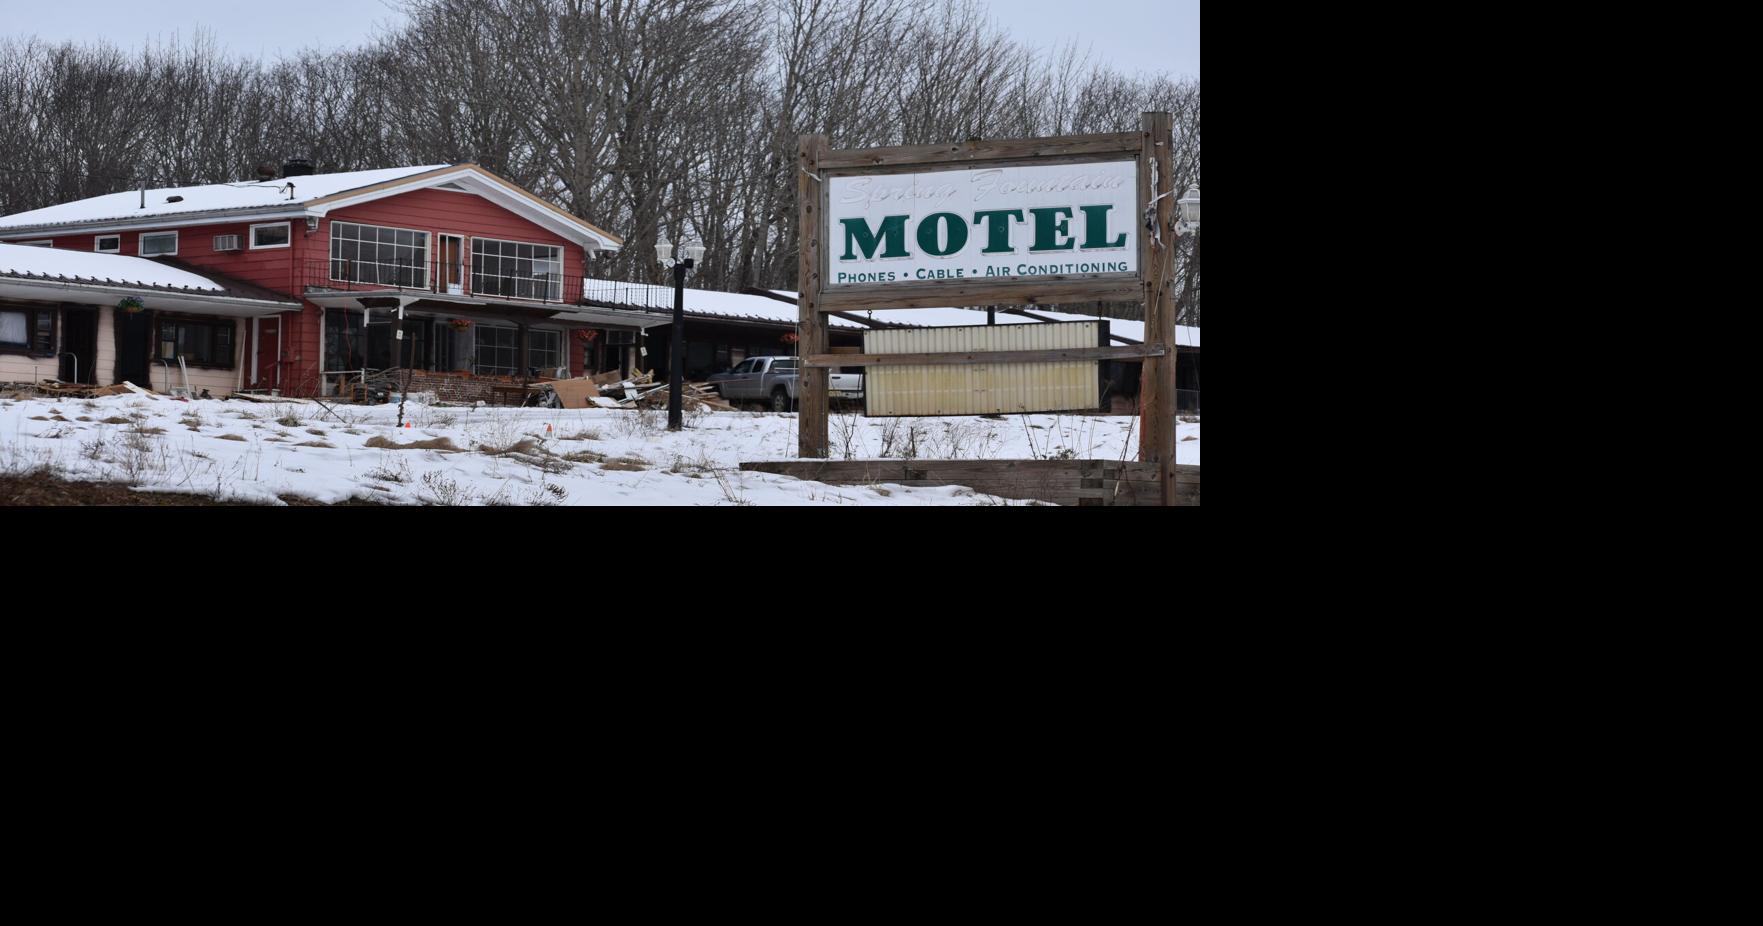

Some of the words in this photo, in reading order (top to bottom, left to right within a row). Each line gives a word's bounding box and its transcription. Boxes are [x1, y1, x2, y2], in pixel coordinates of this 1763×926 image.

[839, 177, 956, 209] Spring
[971, 169, 1123, 202] Fountain
[839, 204, 1128, 261] MOTEL
[838, 271, 896, 284] PHONES
[916, 268, 965, 280] CABLE
[985, 265, 1011, 277] AIR
[1016, 261, 1128, 275] CONDITIONING
